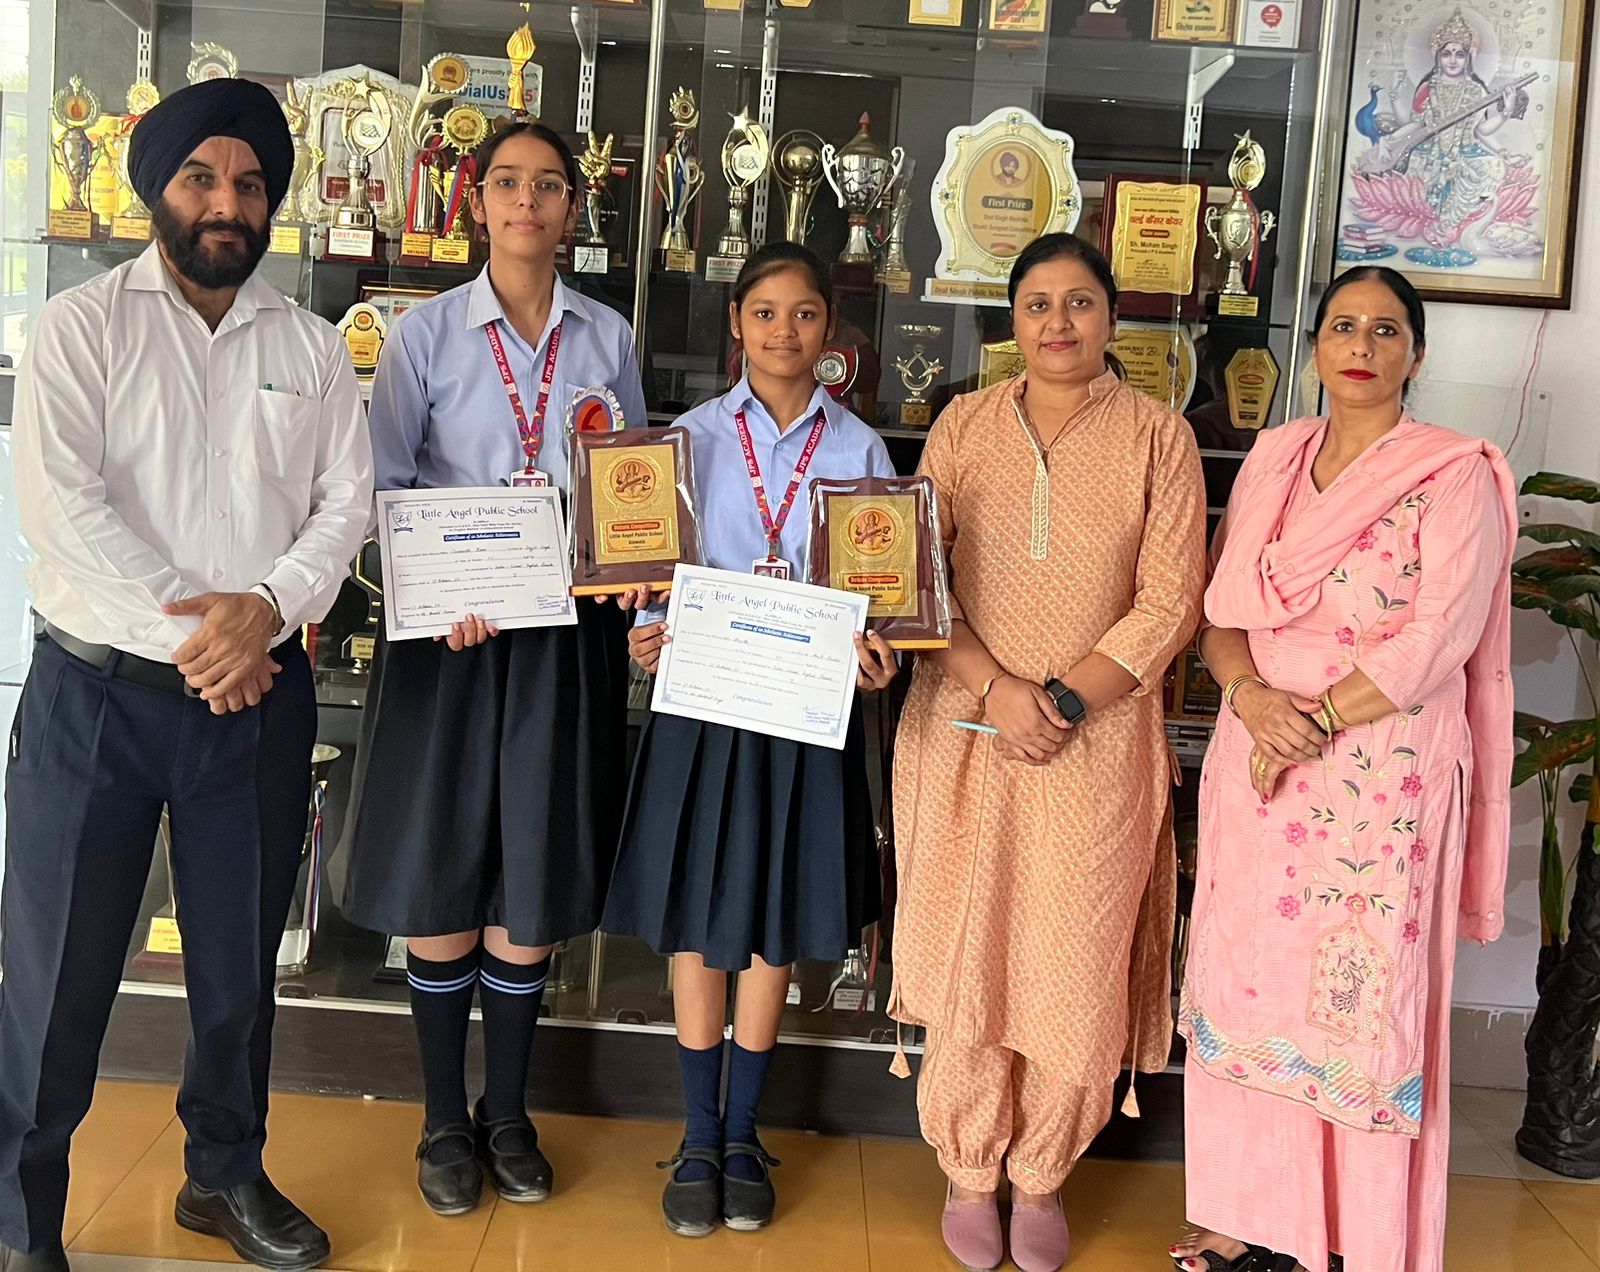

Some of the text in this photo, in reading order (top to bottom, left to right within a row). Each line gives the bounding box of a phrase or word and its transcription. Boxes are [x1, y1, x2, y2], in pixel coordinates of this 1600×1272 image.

[481, 68, 505, 77] proudly
[987, 197, 1027, 209] First Prize
[1161, 242, 1178, 250] Singh
[988, 288, 1008, 298] Schoo
[485, 324, 511, 382] JPS ACADEM
[544, 364, 553, 382] JPS
[747, 458, 757, 475] JPS
[798, 456, 809, 471] JPS
[416, 505, 539, 521] Little Angel Public School
[710, 589, 840, 621] Little Angel Public School
